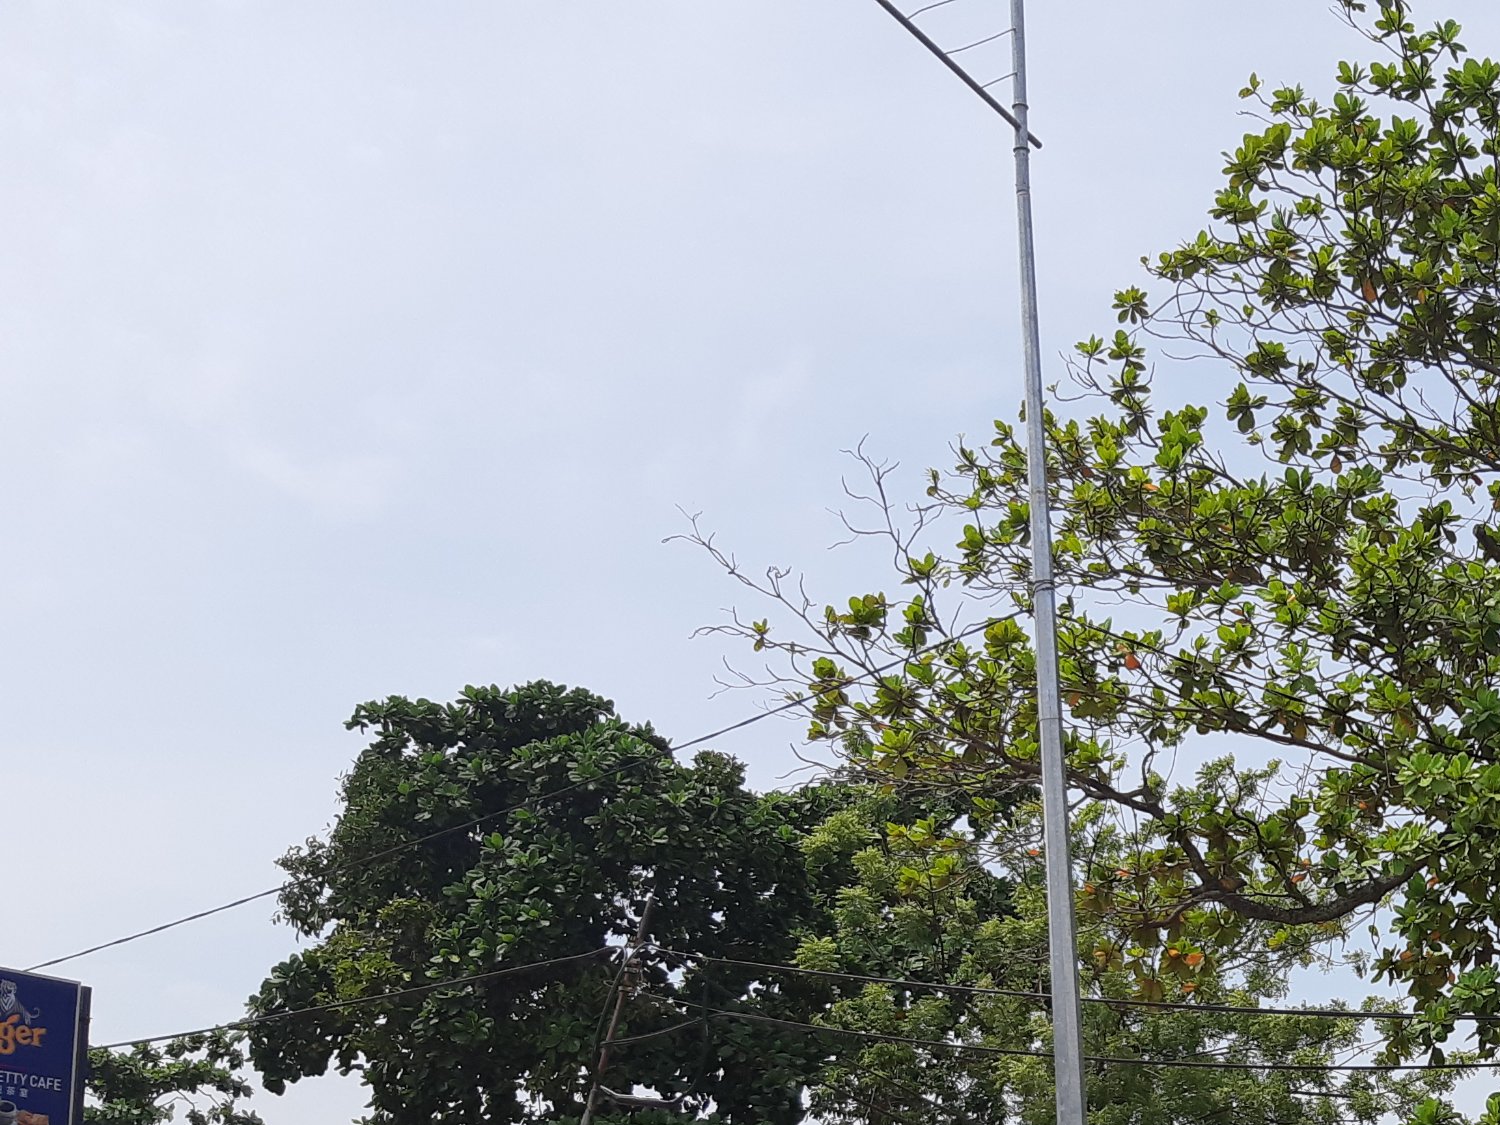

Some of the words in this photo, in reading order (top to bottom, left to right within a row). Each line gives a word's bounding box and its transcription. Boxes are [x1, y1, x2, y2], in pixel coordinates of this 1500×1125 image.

[0, 1014, 47, 1055] ger
[0, 1071, 27, 1085] ETTY
[30, 1075, 61, 1091] CAFE
